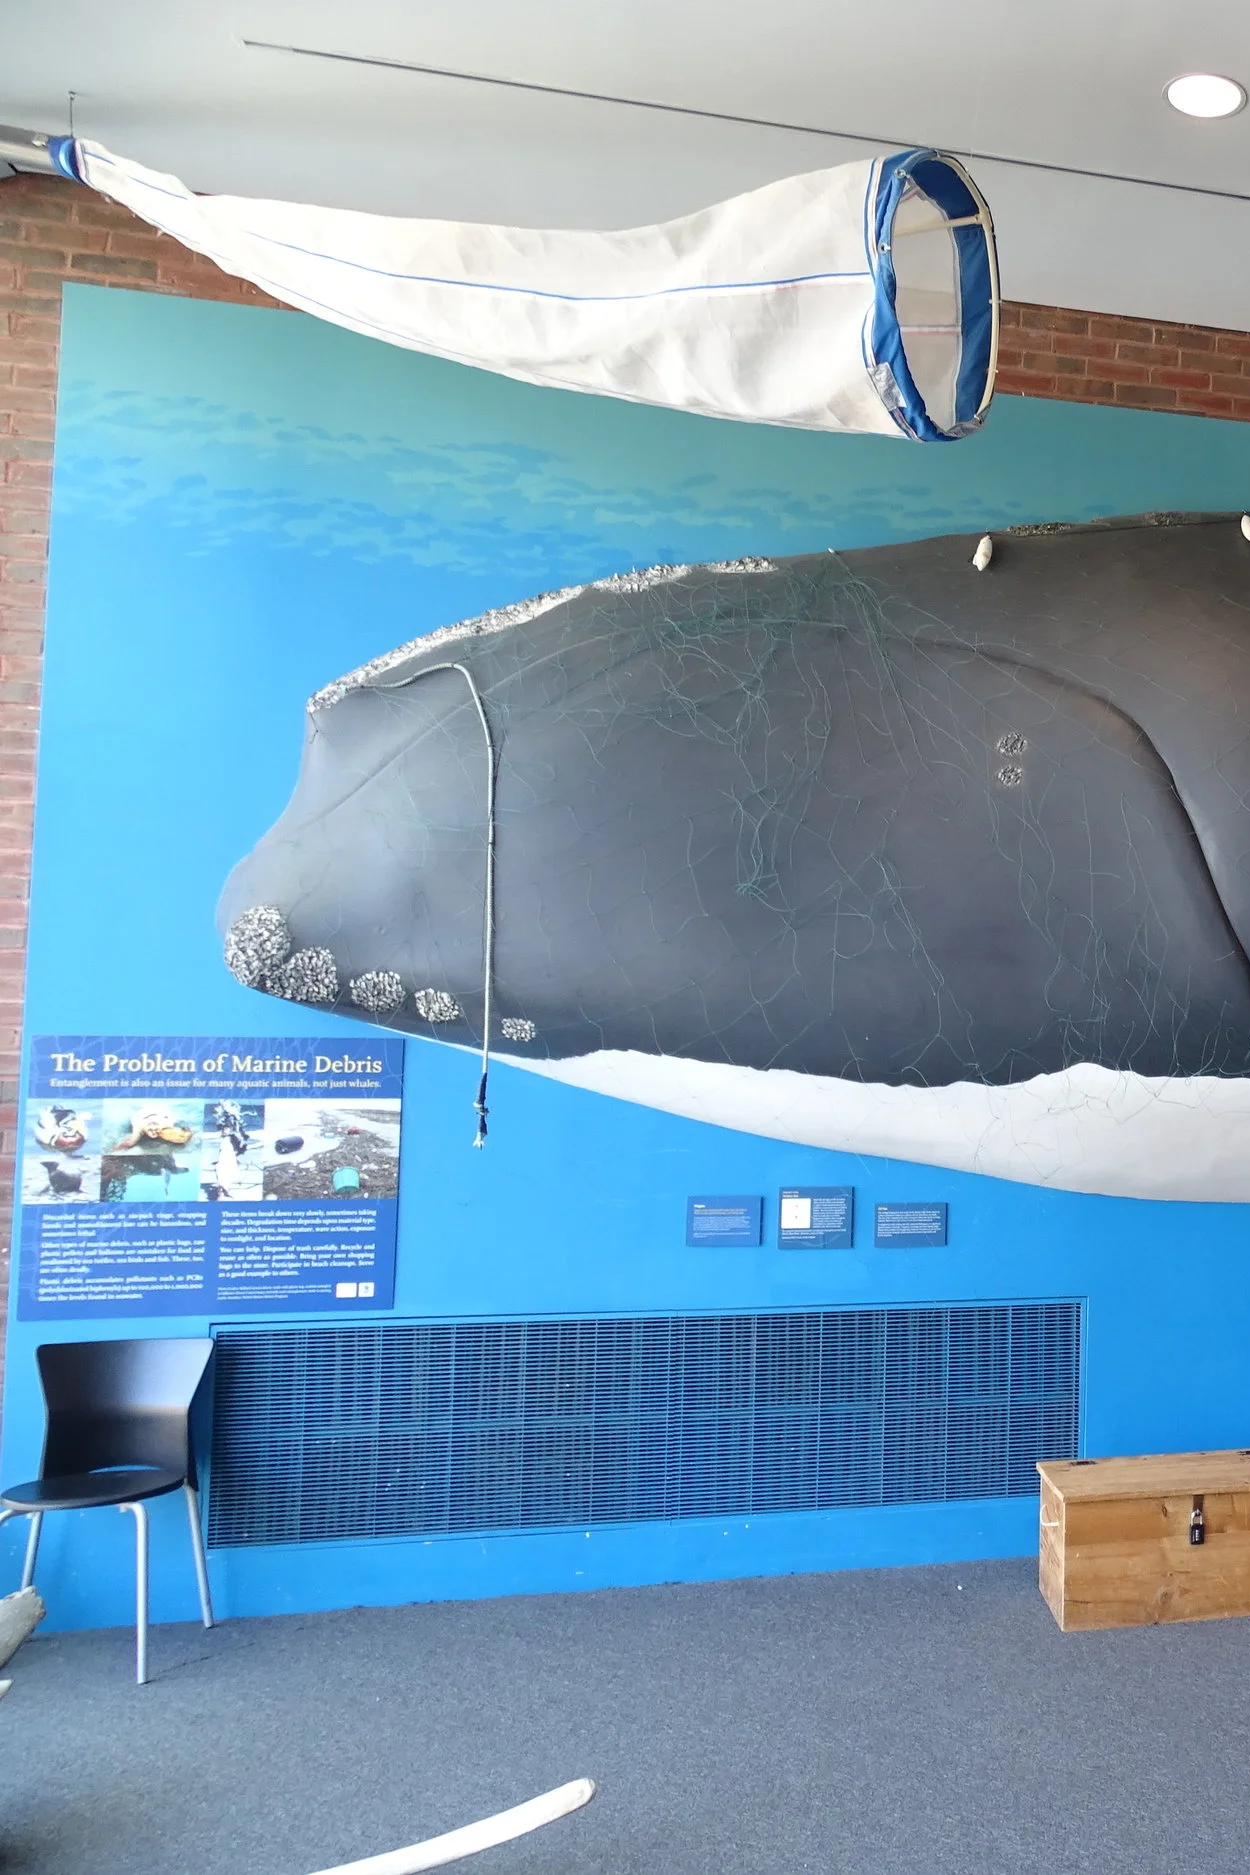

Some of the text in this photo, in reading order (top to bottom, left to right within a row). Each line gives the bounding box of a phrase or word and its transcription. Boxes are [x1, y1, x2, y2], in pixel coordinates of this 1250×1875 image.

[50, 1053, 383, 1074] The Problem of Marine Debris
[50, 1078, 382, 1090] Entanglement is also an issue for many aquatic animals, not just whales.
